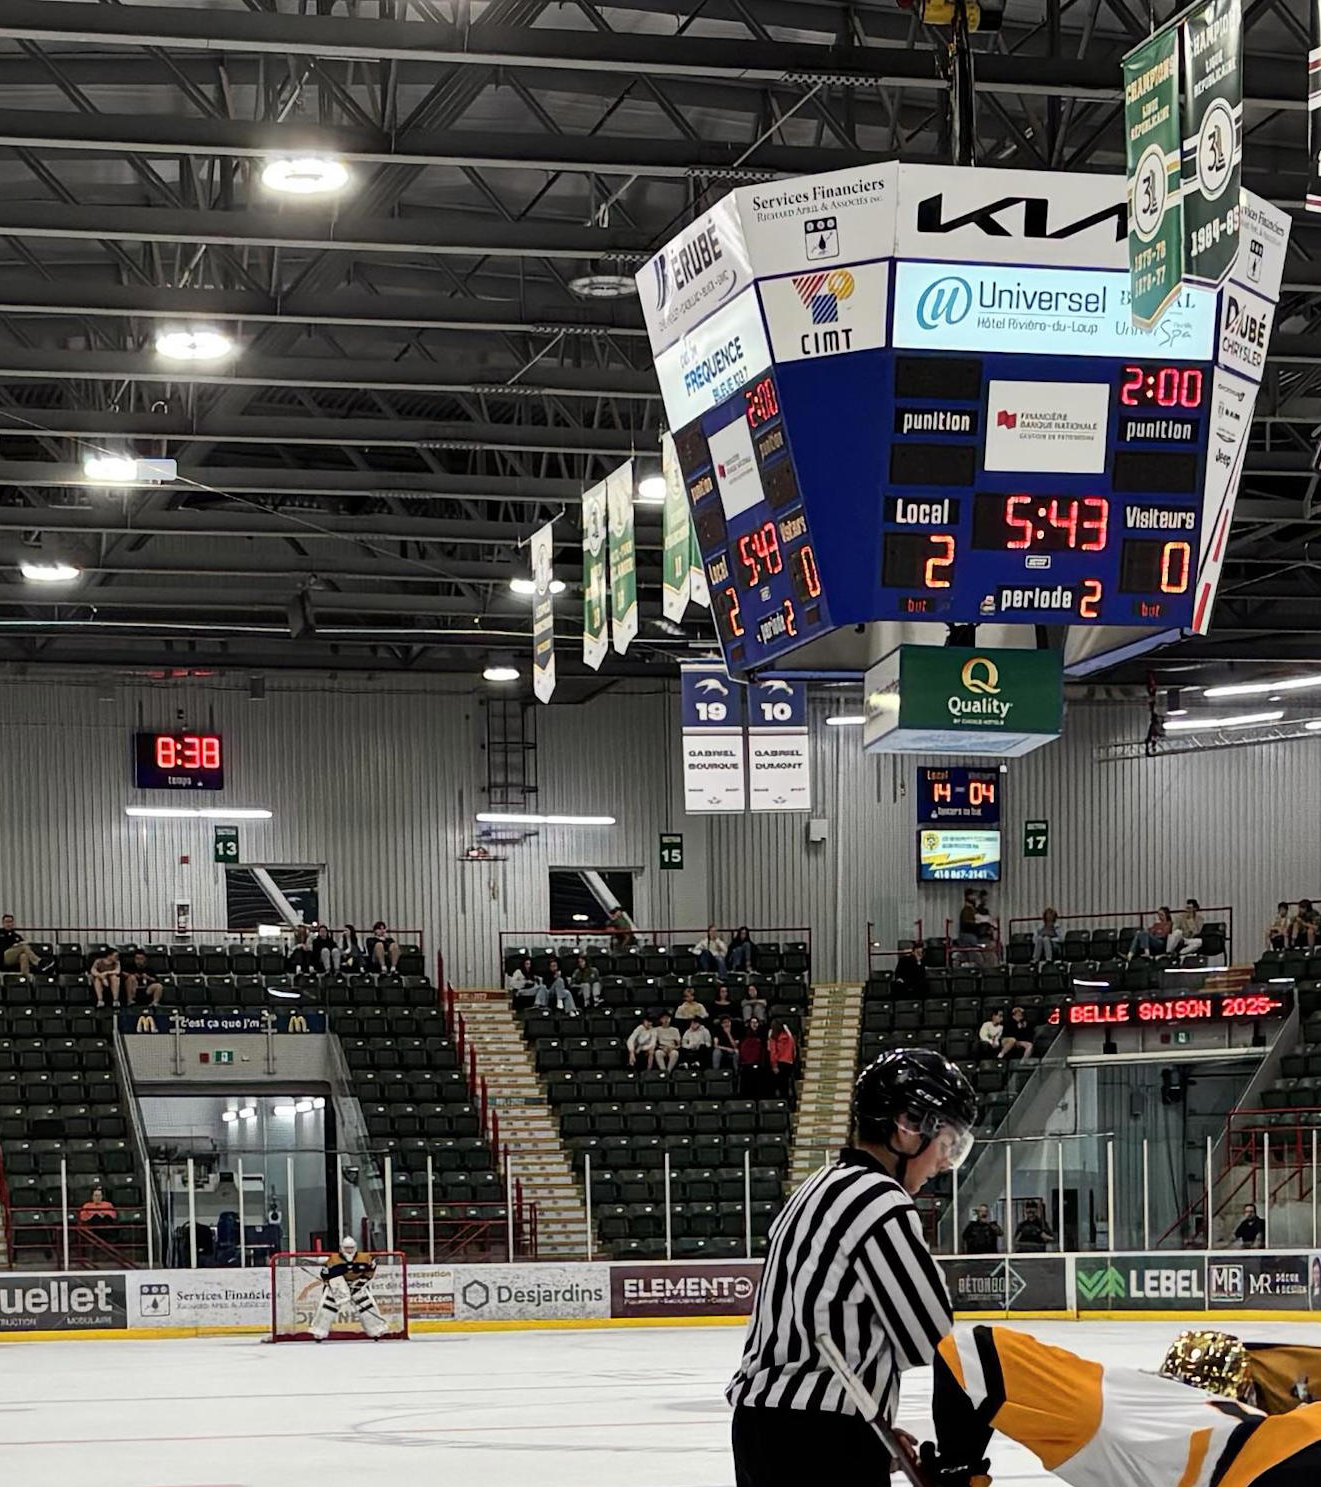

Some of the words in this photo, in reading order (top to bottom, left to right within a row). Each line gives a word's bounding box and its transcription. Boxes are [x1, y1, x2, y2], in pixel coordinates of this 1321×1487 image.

[753, 191, 809, 211] Services
[812, 177, 885, 202] Financiers
[1190, 204, 1240, 258] 1984-85
[979, 280, 1106, 313] Universel
[977, 316, 1006, 331] Hôtel
[1008, 319, 1098, 335] Rivière-du-Loup
[801, 328, 853, 355] CIMT
[1222, 336, 1262, 368] CHRYSLER
[1121, 367, 1203, 408] 2:00
[903, 411, 971, 434] punition
[1126, 420, 1192, 443] punition
[896, 498, 950, 525] Local
[1006, 495, 1110, 551] 5:43
[1126, 506, 1196, 530] Visiteurs
[738, 521, 783, 588] 5:43
[925, 535, 955, 588] 2
[800, 546, 821, 597] 0
[1160, 541, 1190, 593] 0
[907, 597, 928, 613] but
[1001, 586, 1073, 611] periode
[1079, 580, 1102, 618] 2
[1141, 600, 1162, 618] but
[726, 587, 744, 637] 2
[783, 599, 797, 637] 2
[695, 702, 728, 720] 19
[760, 702, 792, 720] 10
[948, 696, 1011, 718] Quality
[157, 737, 220, 768] 8:38
[688, 750, 736, 758] GABRIEL
[754, 750, 802, 758] GABRIEL
[927, 770, 949, 781] Local
[933, 782, 951, 803] 14
[969, 782, 995, 805] 04
[216, 841, 237, 856] 13
[1027, 836, 1047, 850] 17
[661, 848, 682, 863] 15
[1070, 1004, 1130, 1025] BELLE
[1139, 1001, 1212, 1021] SAISON
[1222, 996, 1283, 1017] 2025-
[181, 1017, 205, 1028] c'est
[208, 1018, 219, 1029] ça
[222, 1019, 242, 1029] que
[1129, 1269, 1205, 1299] LEBEL
[1212, 1268, 1241, 1293] MR
[1249, 1273, 1273, 1294] MR
[177, 1291, 222, 1302] Services
[497, 1282, 603, 1305] Desjardins
